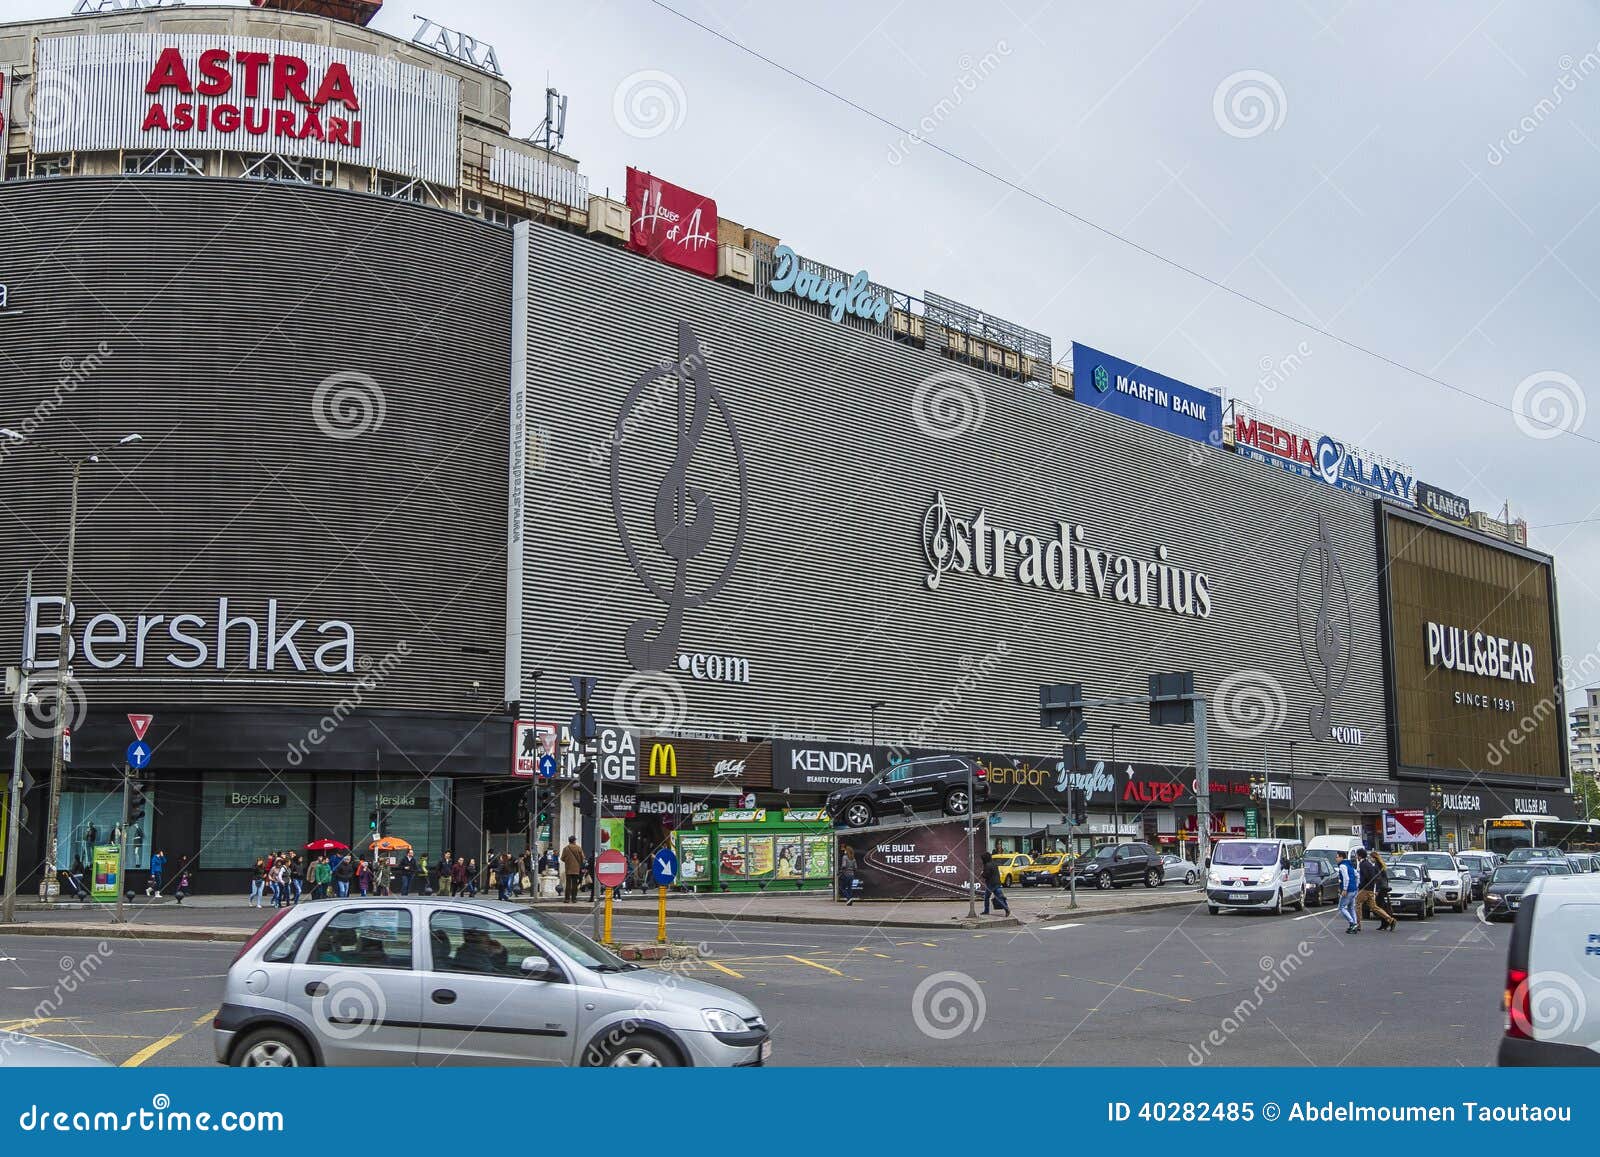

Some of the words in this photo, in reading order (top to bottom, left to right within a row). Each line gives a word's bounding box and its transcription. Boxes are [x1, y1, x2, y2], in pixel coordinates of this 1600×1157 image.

[412, 14, 504, 77] ZARA
[145, 47, 360, 112] ASTRA
[142, 103, 363, 148] ASIGURĂRI
[631, 189, 680, 234] House
[666, 225, 681, 242] of
[677, 208, 717, 252] Art
[769, 244, 890, 324] Douglas
[1116, 374, 1168, 408] MARFIN
[1172, 394, 1207, 422] BANK
[1235, 415, 1316, 468] MEDIA
[1312, 435, 1413, 499] GALAXY
[1426, 490, 1467, 519] FLANCO
[951, 506, 1212, 618] stradivarius
[27, 596, 356, 674] Bershka
[1425, 621, 1536, 684] PULL&BEAR
[1454, 691, 1489, 709] SINCE
[1493, 697, 1516, 713] 1991
[560, 752, 636, 781] IMGE
[791, 749, 874, 774] KENDRA
[806, 775, 830, 784] BEAUTY
[830, 776, 863, 786] COSMETICS
[231, 792, 280, 805] Bershka
[1350, 787, 1396, 805] stradivarius
[1443, 794, 1481, 810] PULL&BEAR
[1514, 798, 1548, 814] PULL&BEAR
[876, 844, 891, 853] WE
[892, 844, 916, 853] BUILT
[885, 855, 905, 864] THE
[906, 855, 925, 864] BEST
[926, 854, 948, 864] JEEP
[935, 865, 957, 874] EVER
